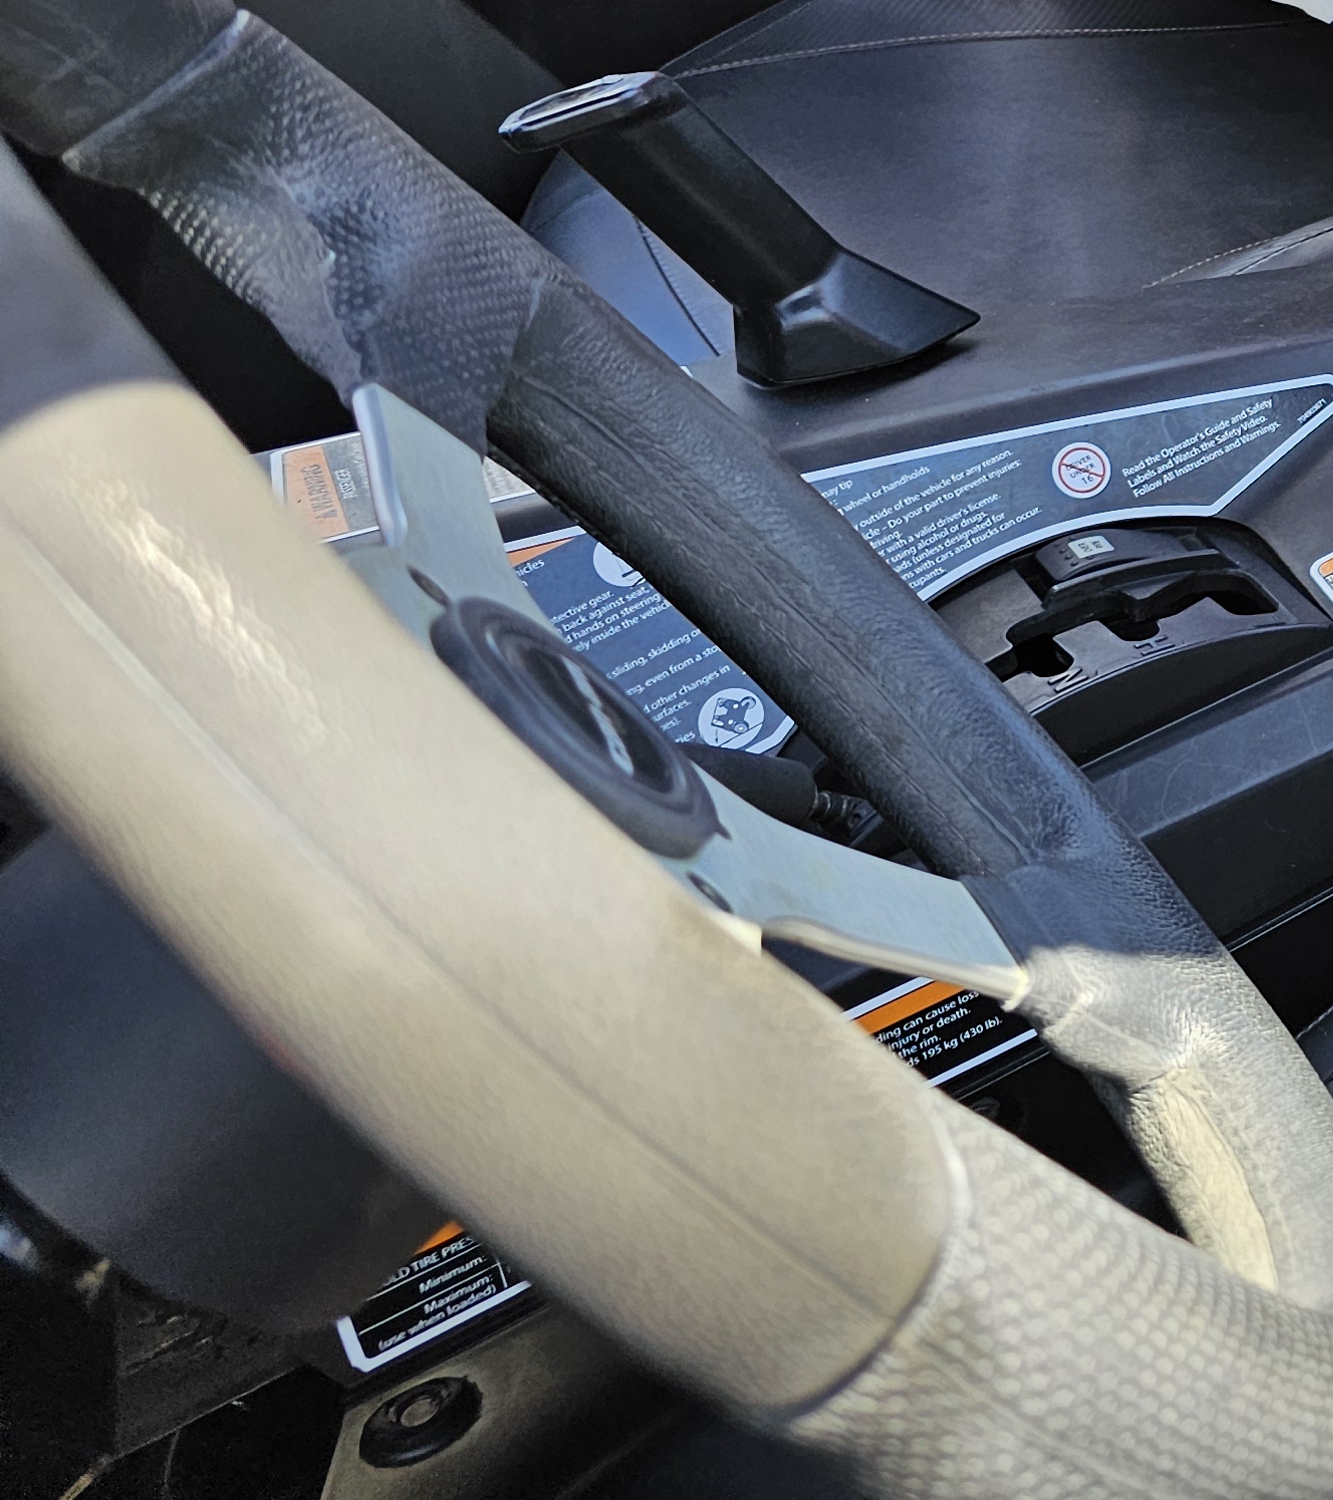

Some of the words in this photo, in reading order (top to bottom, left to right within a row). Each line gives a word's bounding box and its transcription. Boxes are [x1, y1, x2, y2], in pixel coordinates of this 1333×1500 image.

[1121, 459, 1146, 477] Read
[1144, 453, 1161, 466] the
[1160, 432, 1205, 458] Operator's
[1203, 419, 1230, 436] Guide
[1230, 409, 1247, 424] and
[1245, 398, 1272, 416] Safety
[1127, 469, 1157, 488] Labels
[1156, 458, 1174, 474] and
[1172, 446, 1201, 464] Watch
[1199, 439, 1216, 451] the
[1214, 426, 1241, 444] Safety
[1240, 415, 1267, 431] Video.
[1132, 479, 1162, 498] Follow
[1162, 470, 1175, 483] All
[1174, 448, 1224, 477] Instructions
[1224, 438, 1241, 453] and
[1239, 421, 1281, 444] Warnings.
[838, 479, 853, 490] tip
[842, 492, 872, 512] wheel
[871, 488, 882, 498] or
[881, 466, 930, 493] handholds
[859, 507, 893, 527] outside
[893, 499, 904, 511] of
[903, 494, 920, 505] the
[920, 478, 951, 497] vehicle
[950, 471, 964, 482] for
[965, 463, 981, 476] any
[981, 450, 1013, 468] reason.
[861, 528, 880, 540] icle
[886, 517, 903, 528] Do
[902, 506, 923, 523] your
[923, 496, 944, 512] part
[942, 492, 954, 501] to
[954, 474, 988, 497] prevent
[987, 459, 1022, 479] injuries:
[1081, 474, 1094, 485] 16
[885, 537, 908, 553] with
[907, 535, 915, 543] a
[914, 522, 937, 538] valid
[936, 508, 969, 528] driver's
[967, 493, 1001, 512] license.
[890, 546, 917, 563] using
[917, 527, 949, 550] alcohol
[949, 523, 959, 533] or
[960, 511, 989, 527] drugs.
[911, 543, 944, 564] (unless
[943, 517, 992, 547] designated
[991, 512, 1005, 523] for
[913, 559, 935, 574] with
[935, 550, 954, 563] cars
[954, 538, 972, 554] and
[971, 527, 999, 544] trucks
[999, 519, 1016, 531] can
[1015, 506, 1042, 523] occur.
[561, 614, 588, 632] back
[588, 596, 625, 619] against
[625, 586, 650, 601] seat,
[571, 620, 605, 640] hands
[604, 613, 618, 624] on
[619, 592, 661, 617] steering
[588, 590, 614, 608] gear.
[590, 625, 621, 644] inside
[620, 616, 639, 629] the
[611, 656, 648, 677] sliding,
[647, 633, 691, 659] skidding
[644, 670, 670, 686] even
[668, 657, 694, 674] from
[694, 653, 702, 661] a
[650, 691, 677, 710] other
[678, 670, 719, 695] changes
[718, 664, 730, 674] in
[902, 1016, 923, 1031] can
[925, 1000, 956, 1020] cause
[957, 987, 979, 1004] loss
[922, 1023, 934, 1034] or
[936, 1007, 971, 1028] death.
[897, 1045, 917, 1059] the
[919, 1035, 941, 1049] rim.
[922, 1044, 942, 1060] 195
[943, 1037, 958, 1050] kg
[959, 1024, 983, 1042] (430
[984, 1016, 1002, 1029] lb).
[410, 1251, 440, 1271] TIRE
[419, 1256, 486, 1293] Minimum:
[423, 1275, 492, 1313] Maximum:
[378, 1331, 406, 1351] (use
[407, 1311, 445, 1335] when
[446, 1284, 496, 1315] loaded)
